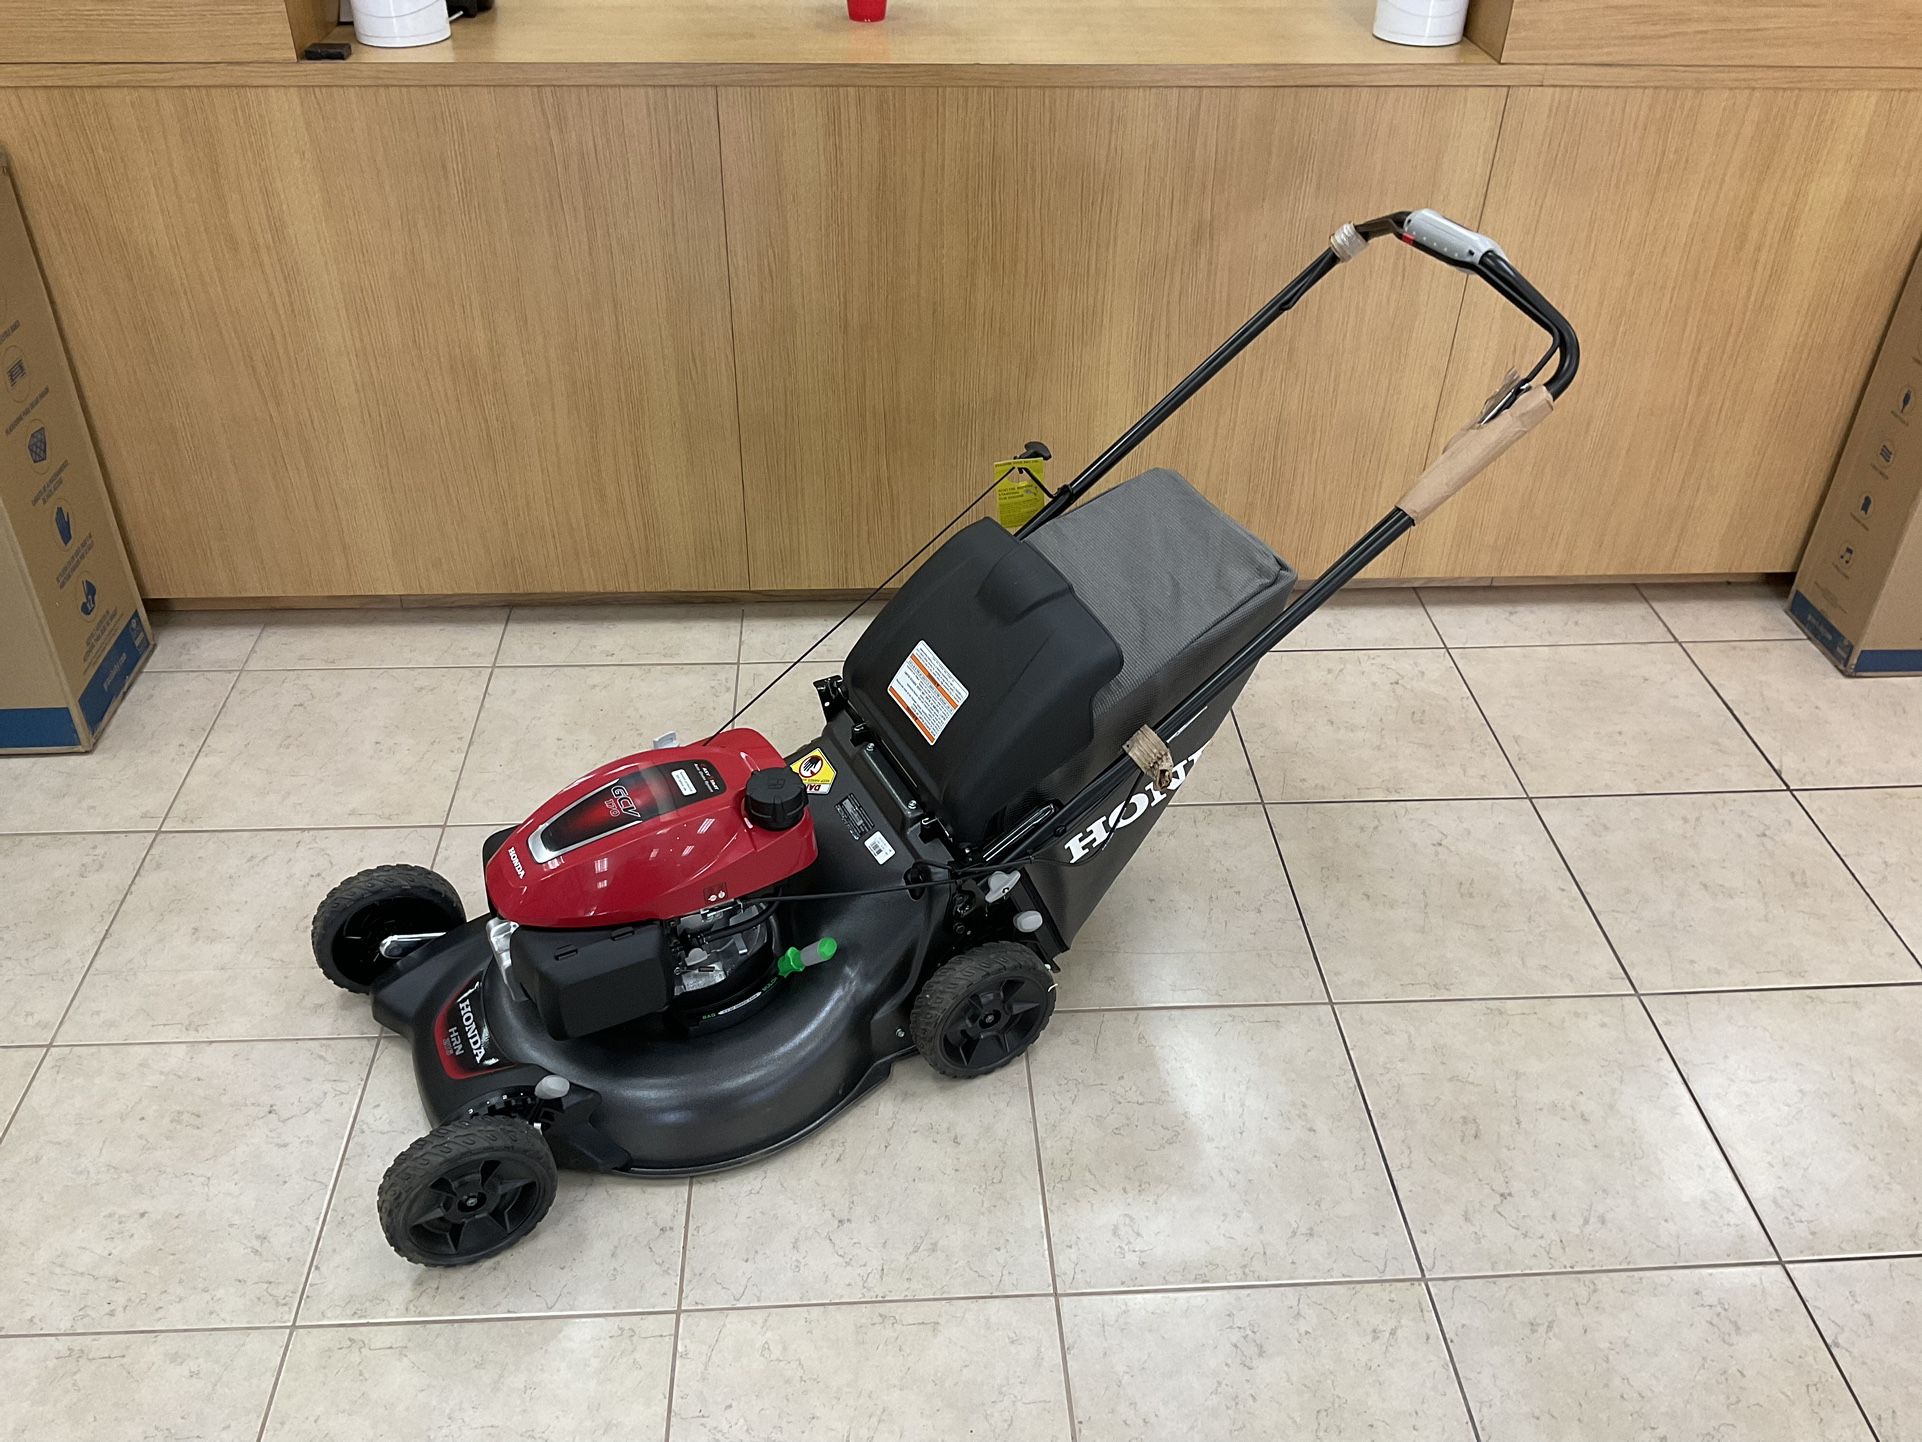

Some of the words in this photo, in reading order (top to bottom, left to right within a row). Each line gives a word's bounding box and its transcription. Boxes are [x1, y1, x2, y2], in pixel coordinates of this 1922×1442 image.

[604, 799, 621, 818] 170
[611, 785, 641, 818] GCV
[1064, 740, 1210, 863] HON
[508, 846, 526, 880] HONDA
[459, 998, 486, 1064] HONDA
[702, 1012, 716, 1020] BAG
[448, 1026, 465, 1056] HRN
